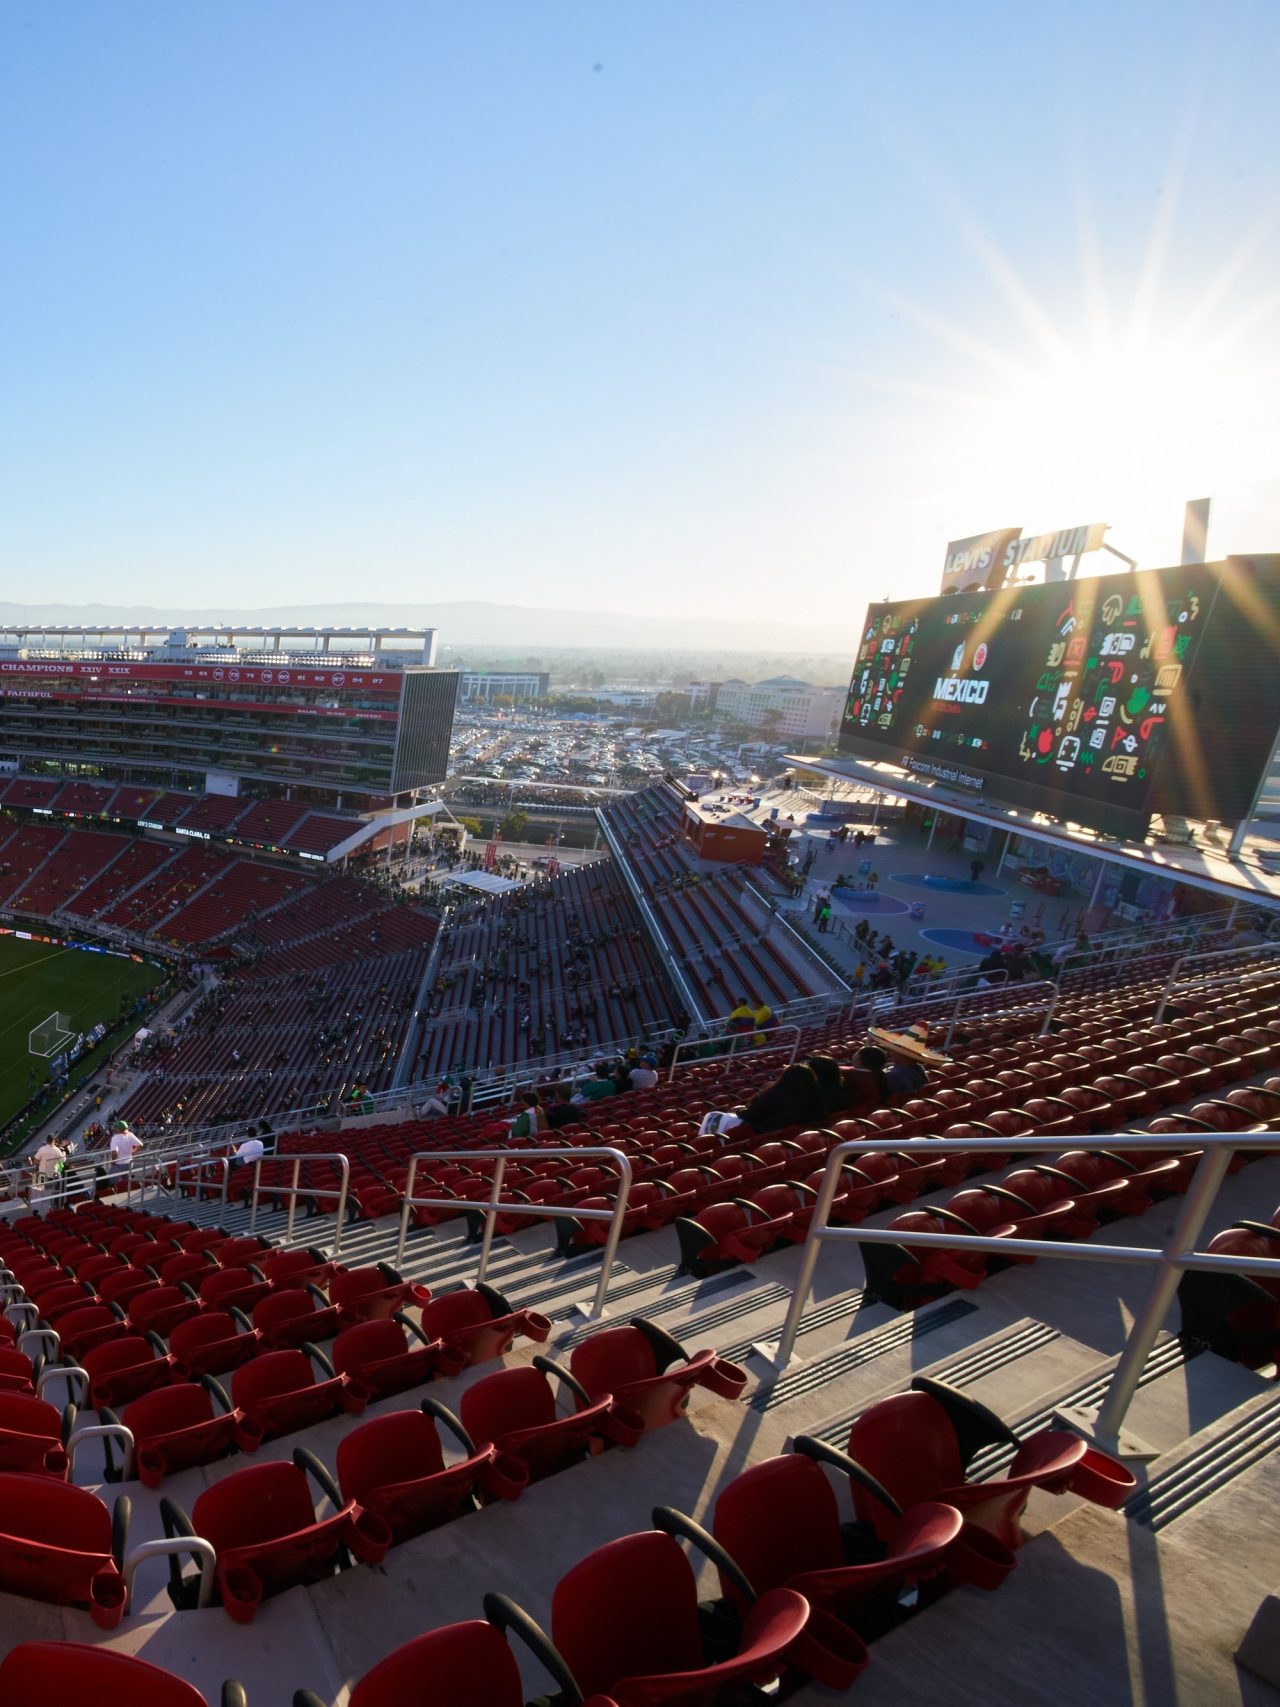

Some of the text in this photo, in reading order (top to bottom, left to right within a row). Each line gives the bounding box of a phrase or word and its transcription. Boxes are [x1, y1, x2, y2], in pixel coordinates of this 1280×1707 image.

[1003, 524, 1091, 566] STADIUM
[1, 663, 74, 673] CHAMPIONS
[7, 690, 53, 698] FAITHFUL
[933, 673, 990, 705] MÉXICO
[909, 757, 984, 789] Foxconn Industrial Internet
[175, 827, 189, 835] SANTA
